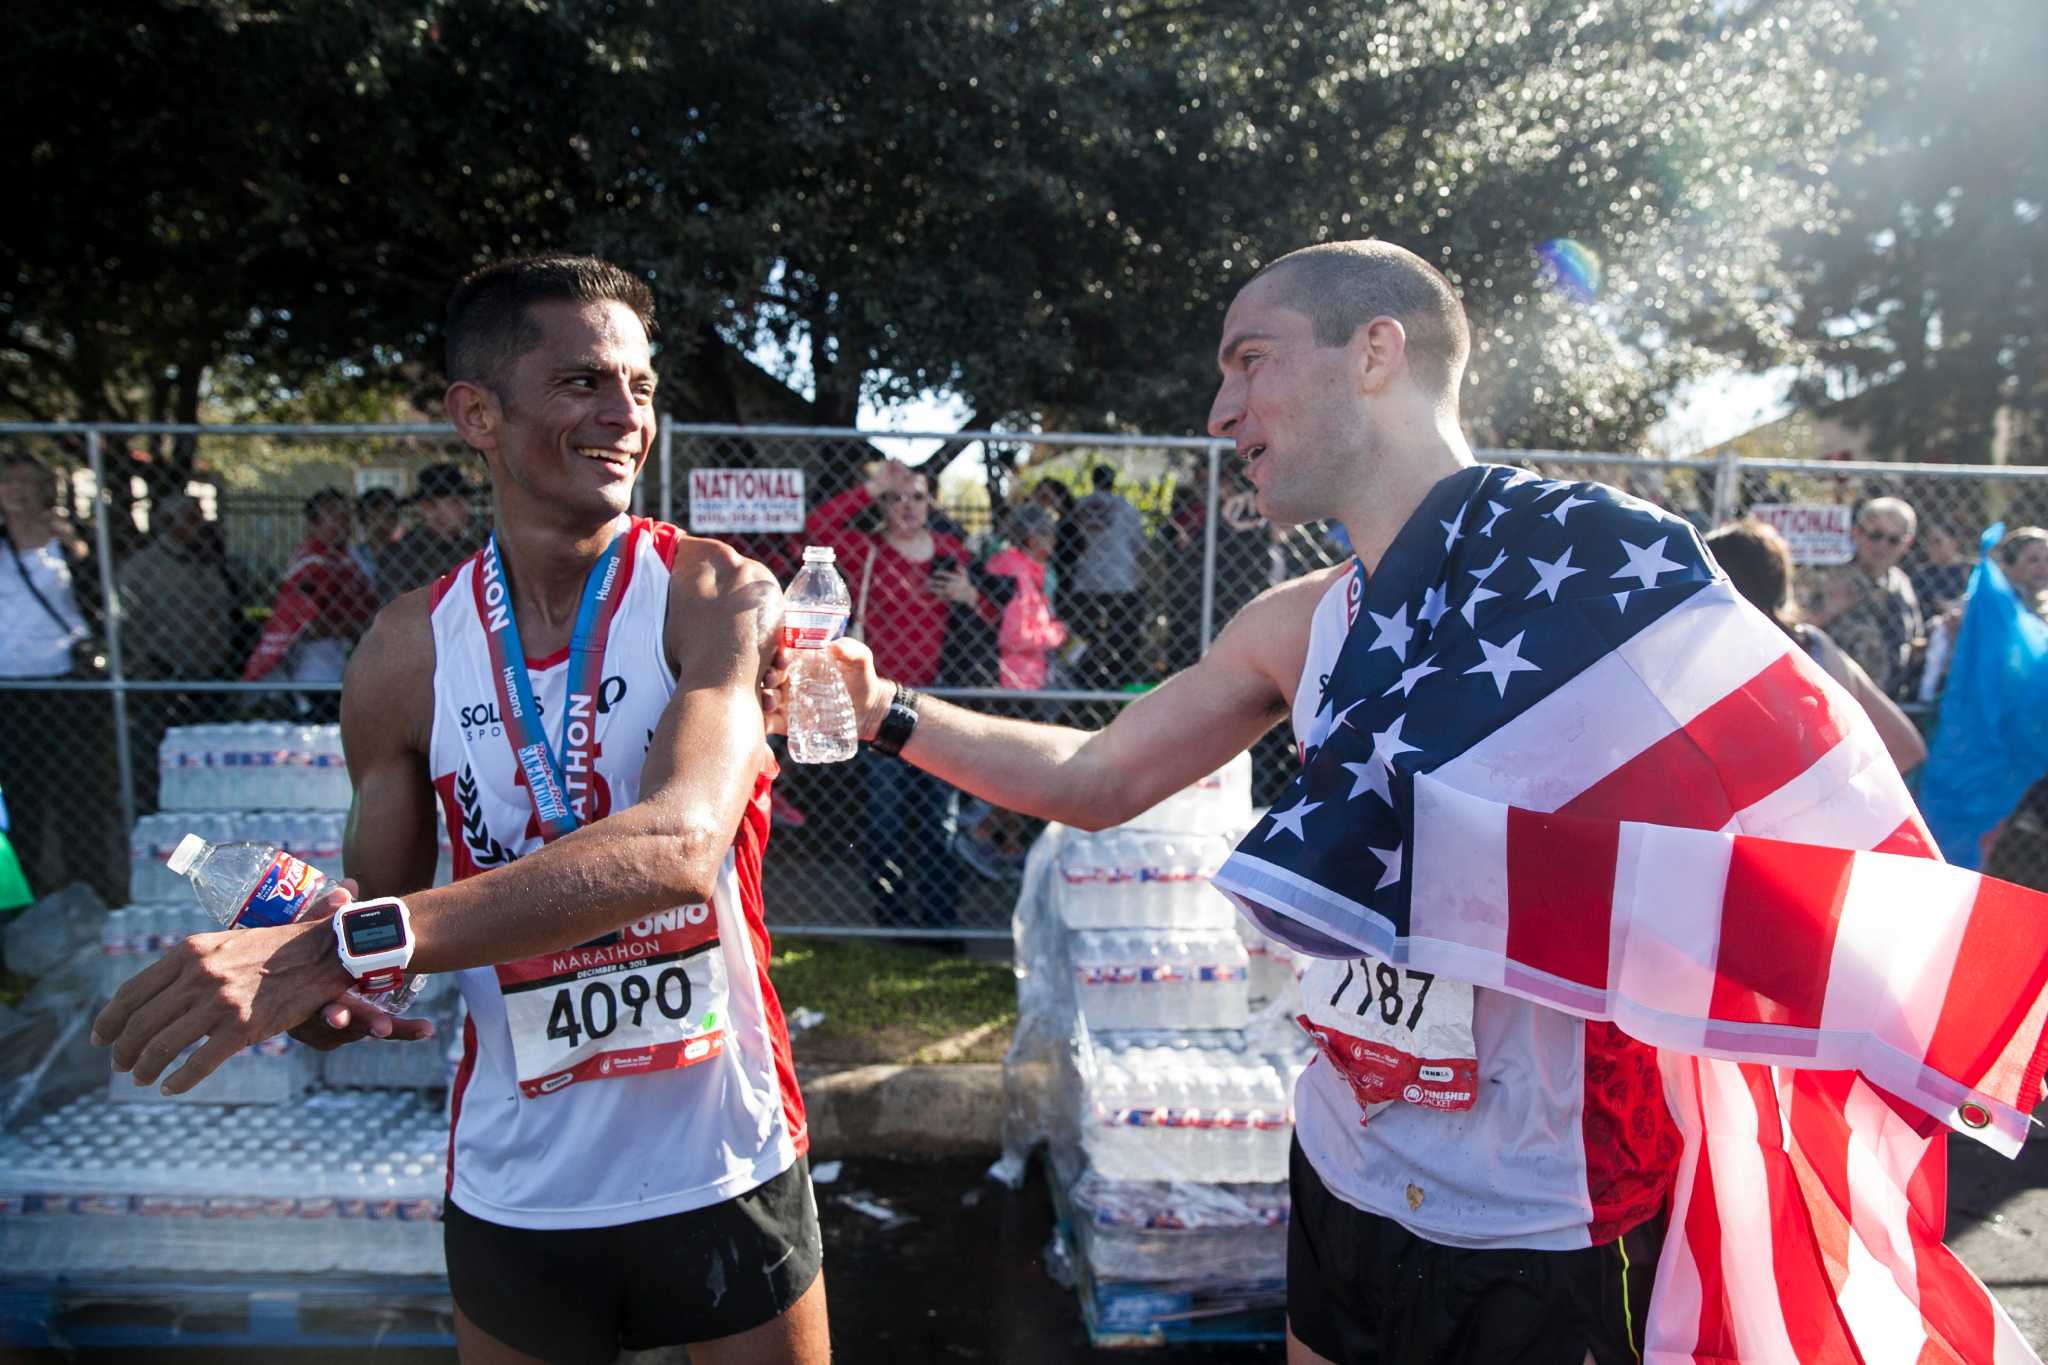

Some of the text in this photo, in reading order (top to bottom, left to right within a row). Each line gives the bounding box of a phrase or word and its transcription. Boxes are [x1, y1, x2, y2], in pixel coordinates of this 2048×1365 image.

[695, 474, 799, 498] NATIONAL
[595, 556, 621, 601] Humana
[503, 666, 523, 719] Humana
[621, 903, 709, 939] ONIO
[552, 940, 660, 973] MARATHON
[576, 964, 618, 979] DECEMBER
[547, 967, 692, 1048] 4090
[1424, 1089, 1471, 1101] FINISHER
